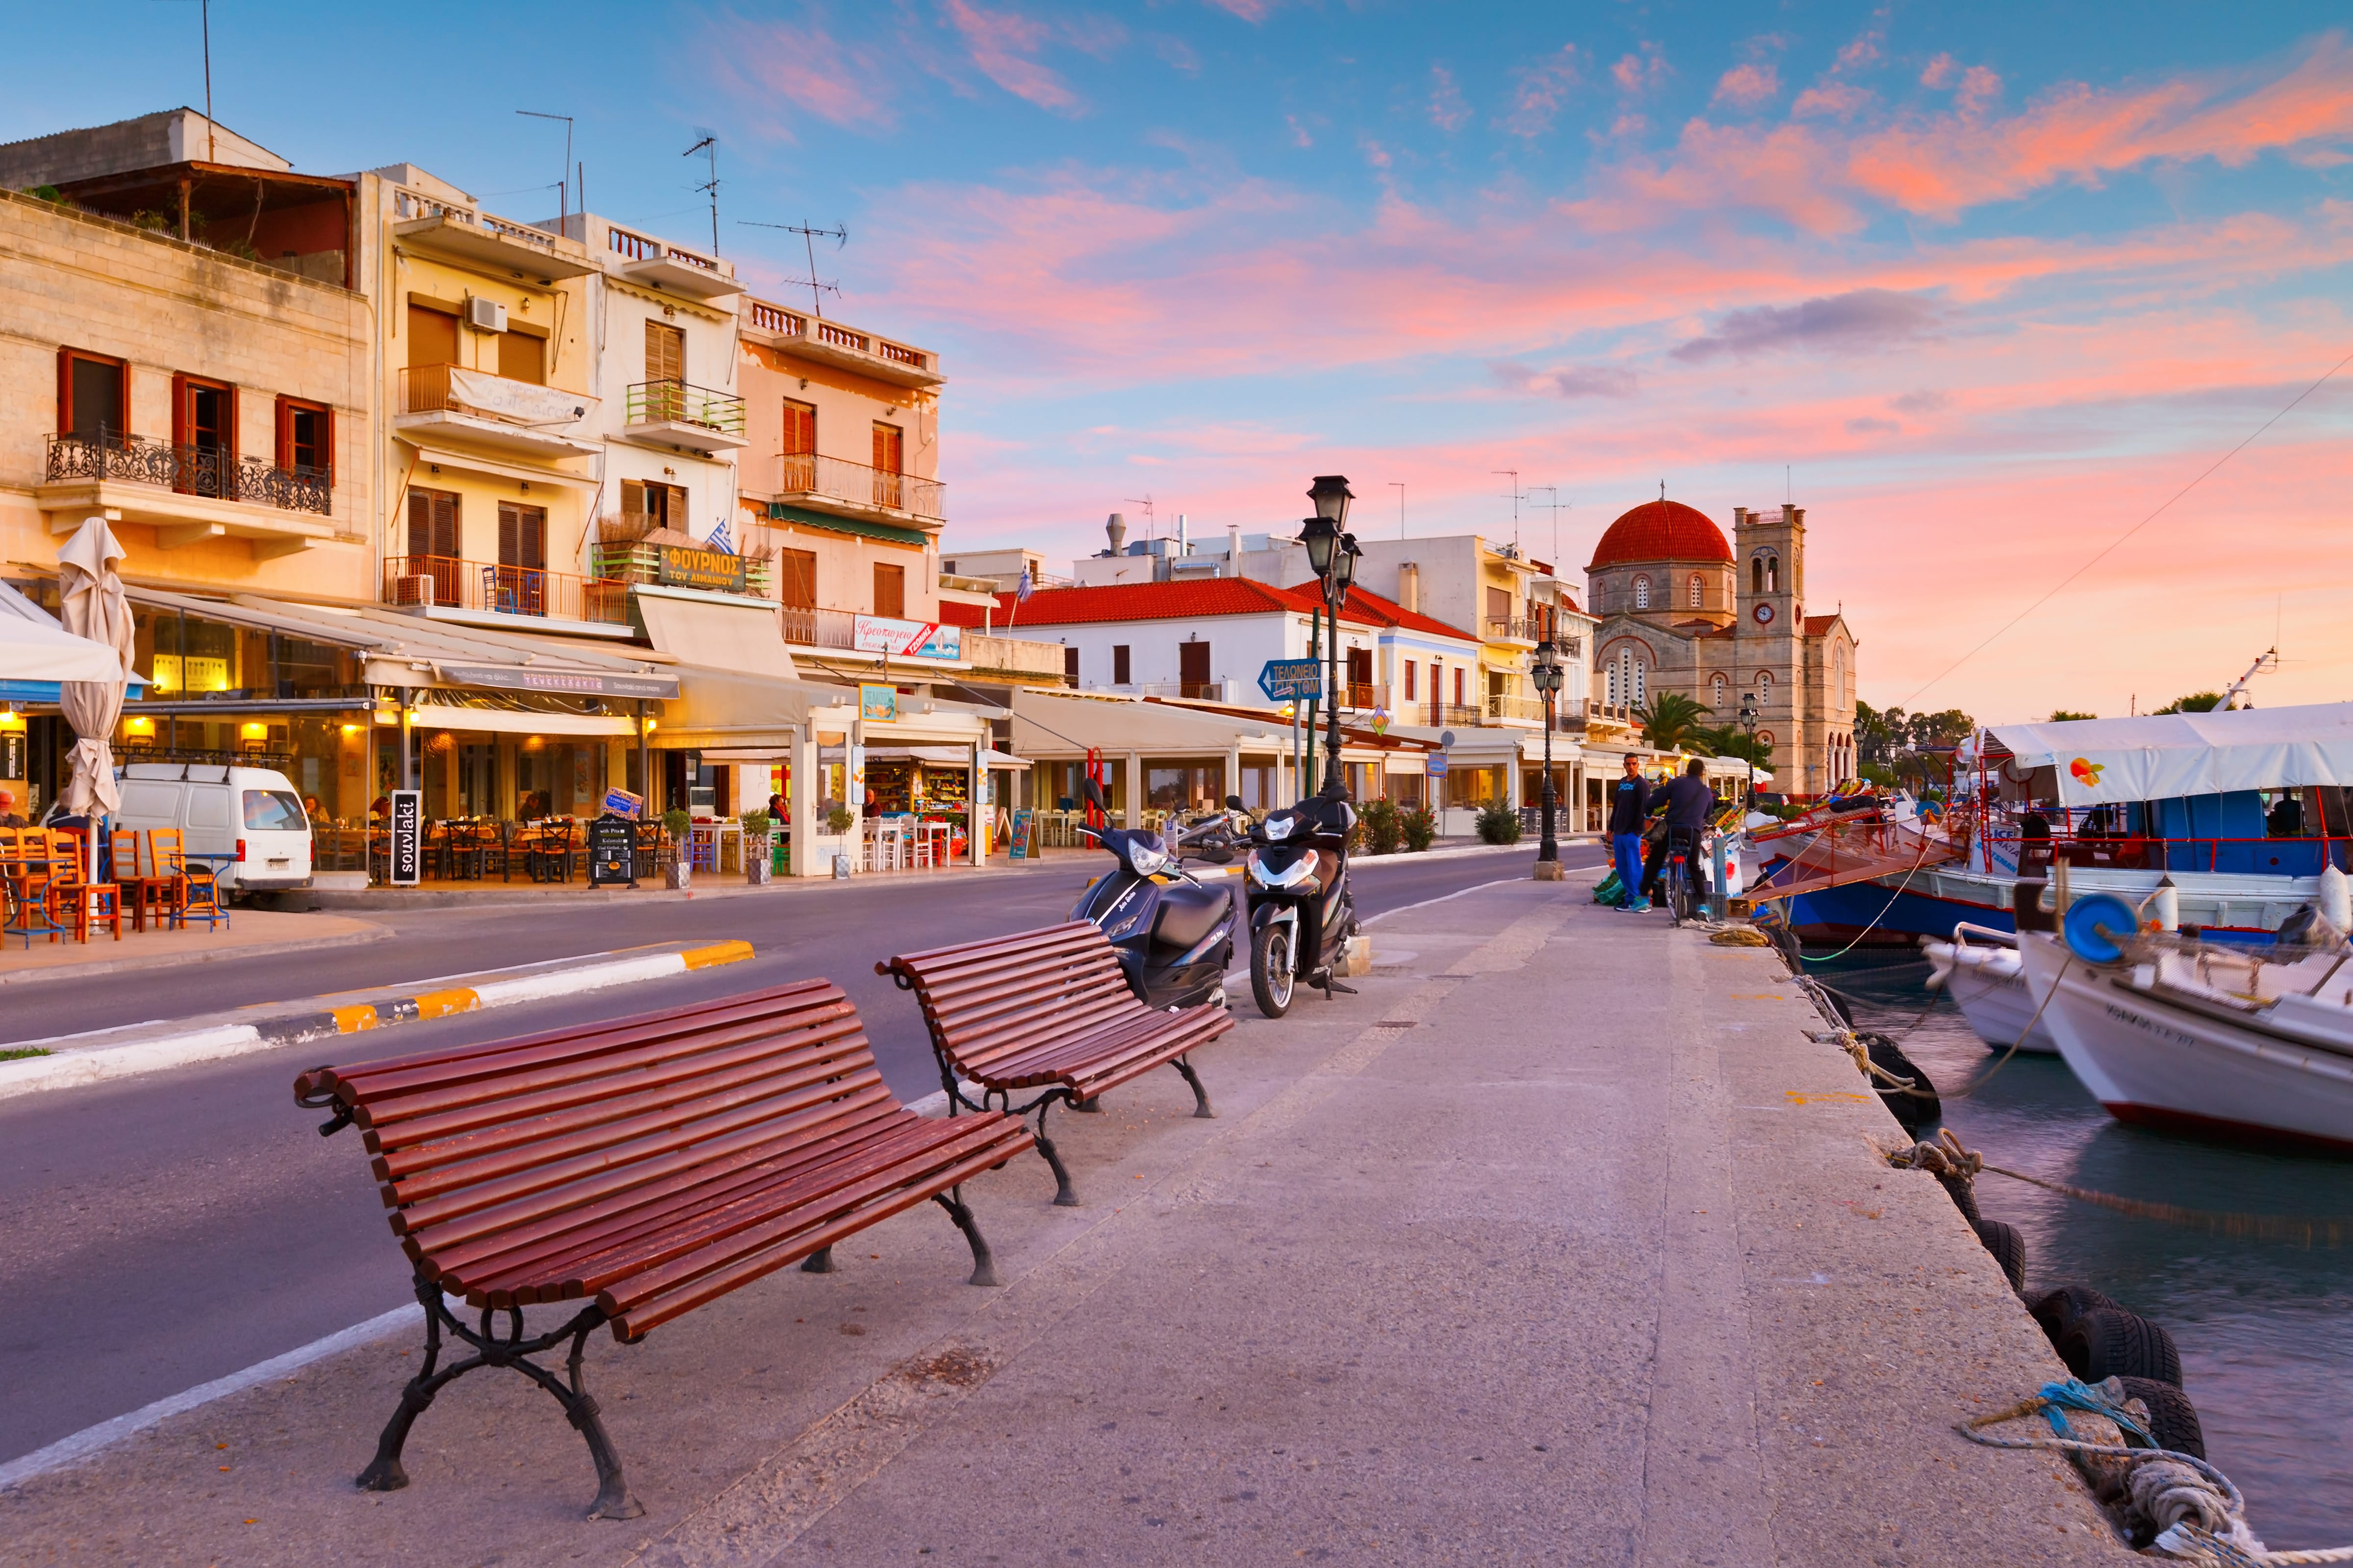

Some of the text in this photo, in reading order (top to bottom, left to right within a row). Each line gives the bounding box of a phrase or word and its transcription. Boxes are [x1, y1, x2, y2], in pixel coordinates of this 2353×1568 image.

[669, 548, 740, 576] ΦΟΥΡΝΟΣ
[691, 573, 733, 586] ΛΙΜΑΝΙΟΥ
[908, 625, 932, 654] ΤΖΩΝΗΣ
[1273, 664, 1318, 680] ΤΕΛΩΝΕΙΟ
[397, 802, 414, 872] souvlaki
[1994, 829, 2014, 839] ICE
[1976, 842, 2017, 873] STSMAN
